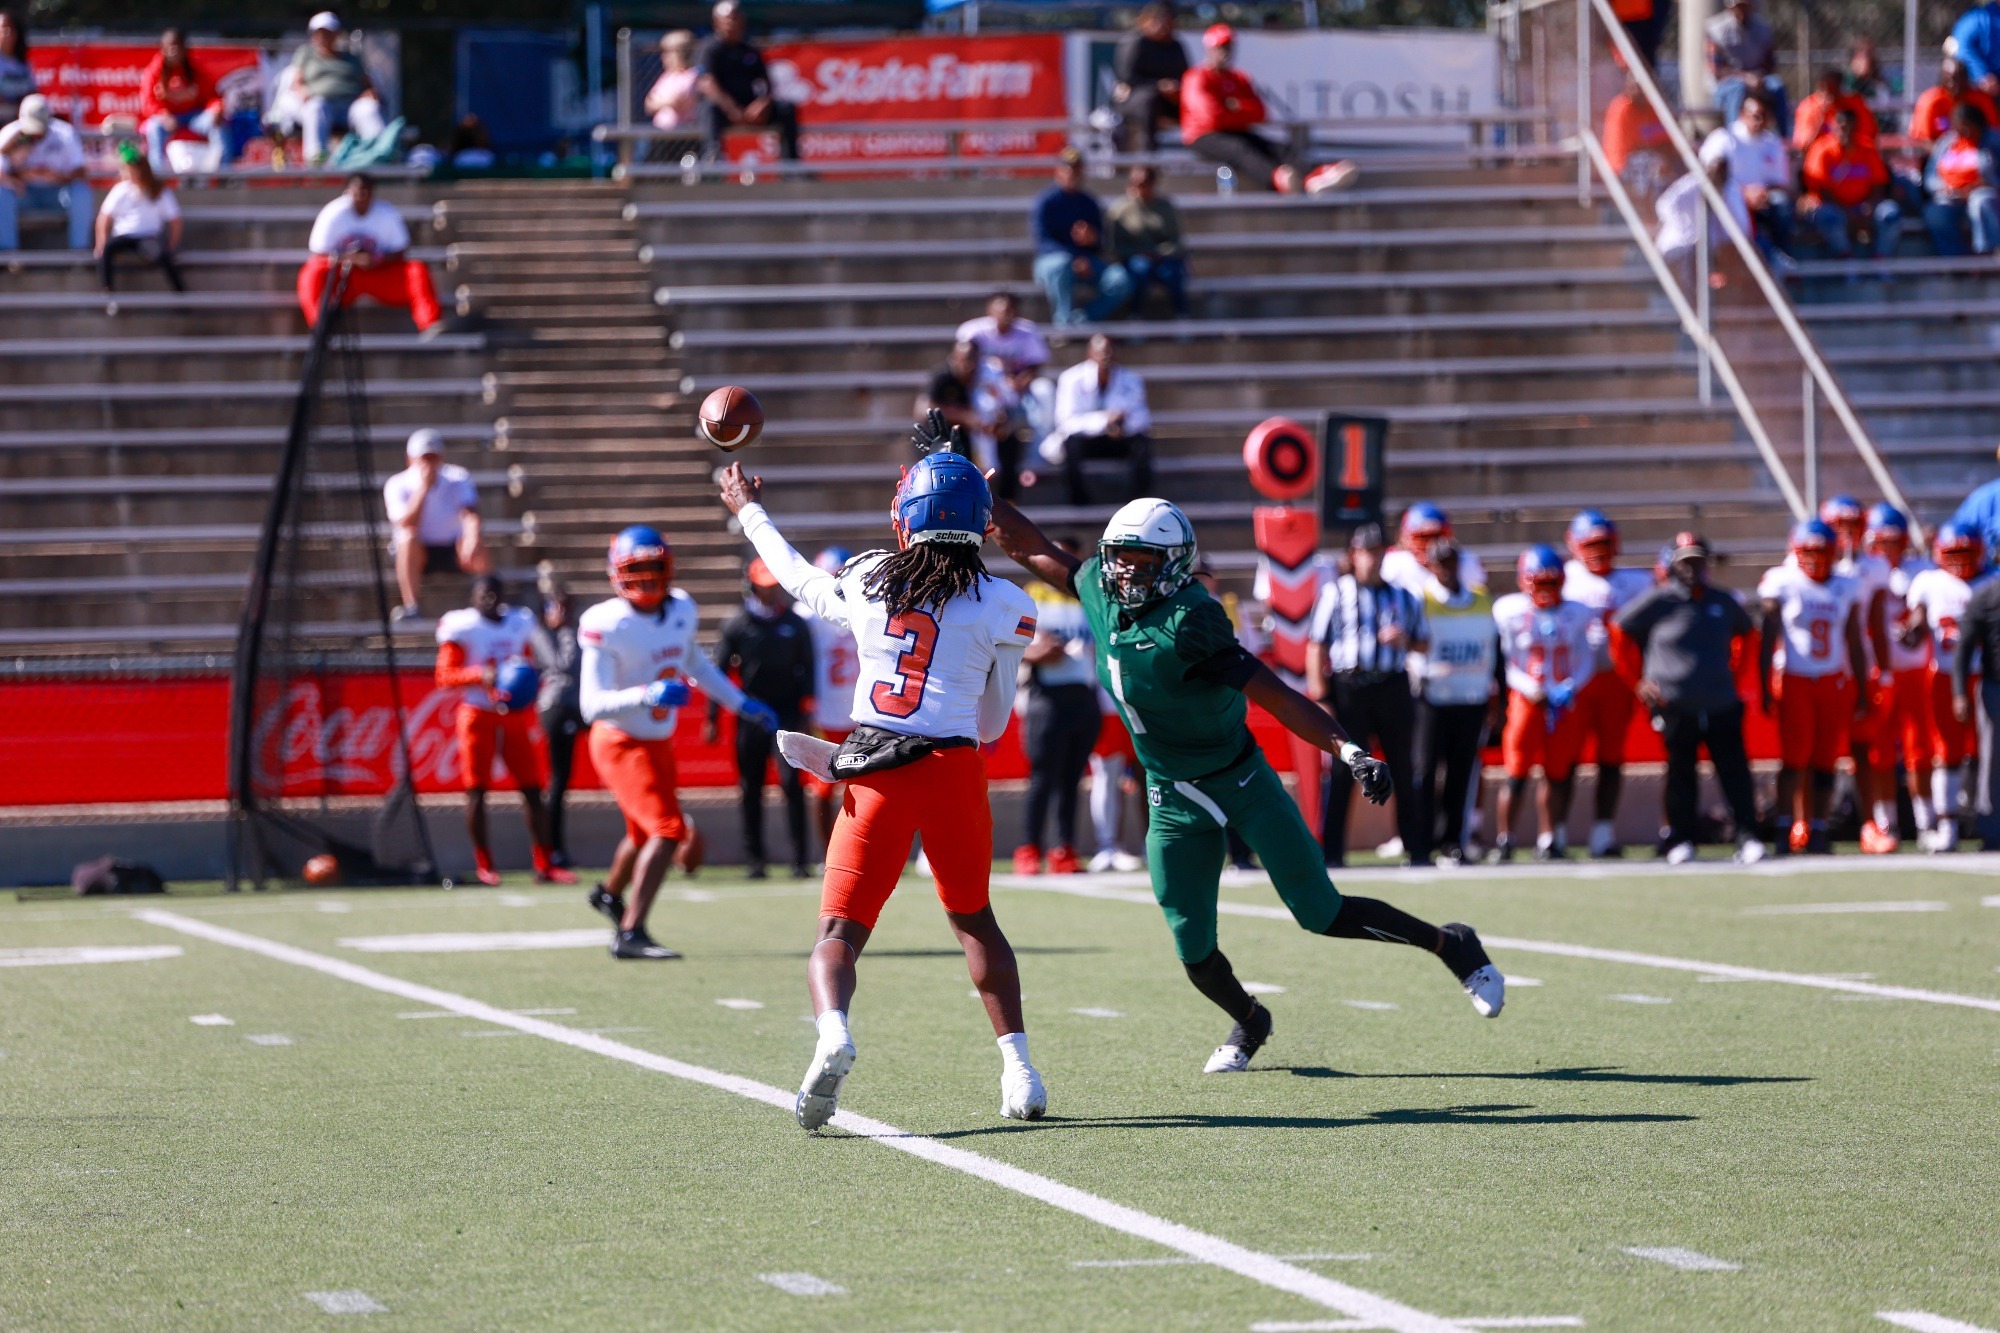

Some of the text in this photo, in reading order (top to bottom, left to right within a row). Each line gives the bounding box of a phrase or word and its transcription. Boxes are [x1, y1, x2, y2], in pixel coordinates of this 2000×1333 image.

[1257, 80, 1472, 117] NTOSH
[939, 511, 945, 520] 3
[935, 530, 969, 541] schutt
[870, 608, 940, 719] 3
[1106, 655, 1147, 734] 1
